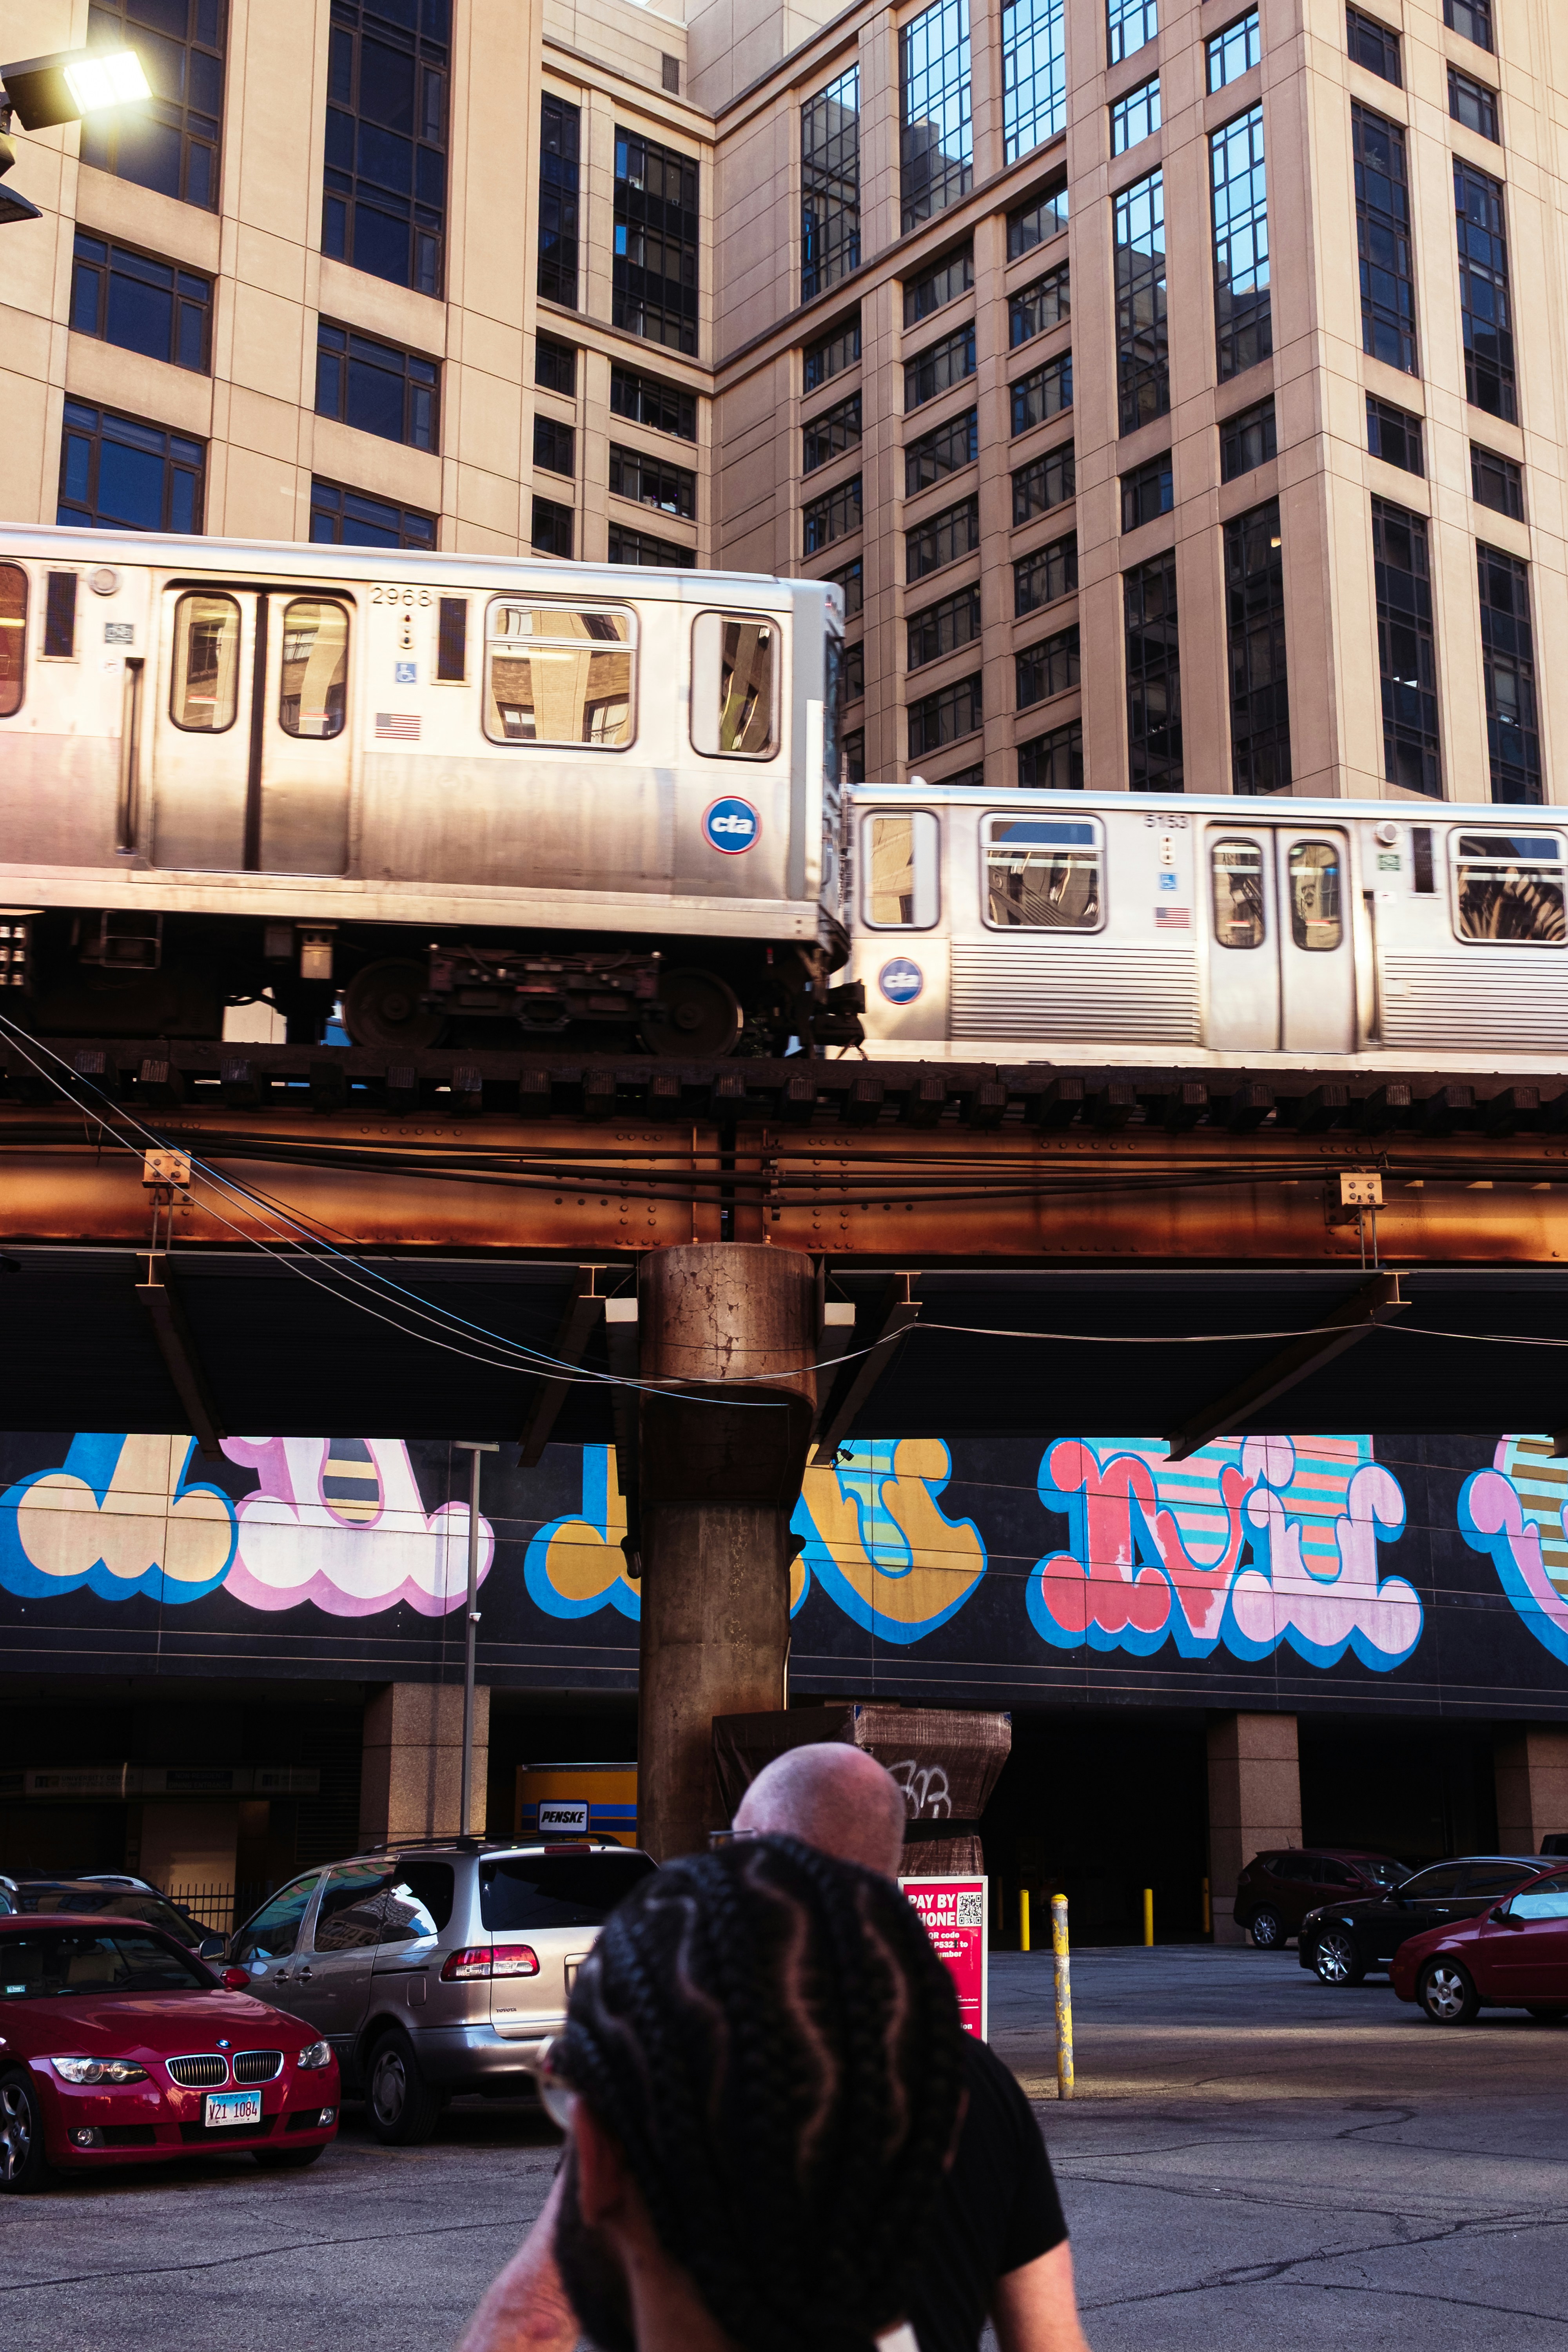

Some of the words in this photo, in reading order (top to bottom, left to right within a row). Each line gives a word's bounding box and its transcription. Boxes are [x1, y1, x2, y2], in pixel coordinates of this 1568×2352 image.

[370, 588, 432, 606] 2968
[711, 815, 753, 834] cta
[883, 972, 919, 988] cta
[541, 1811, 585, 1823] PENSKE
[908, 1894, 934, 1908] PAY
[937, 1894, 956, 1908] BY
[918, 1912, 956, 1926] HONE
[210, 2103, 227, 2120] V21
[234, 2101, 257, 2118] 1084
